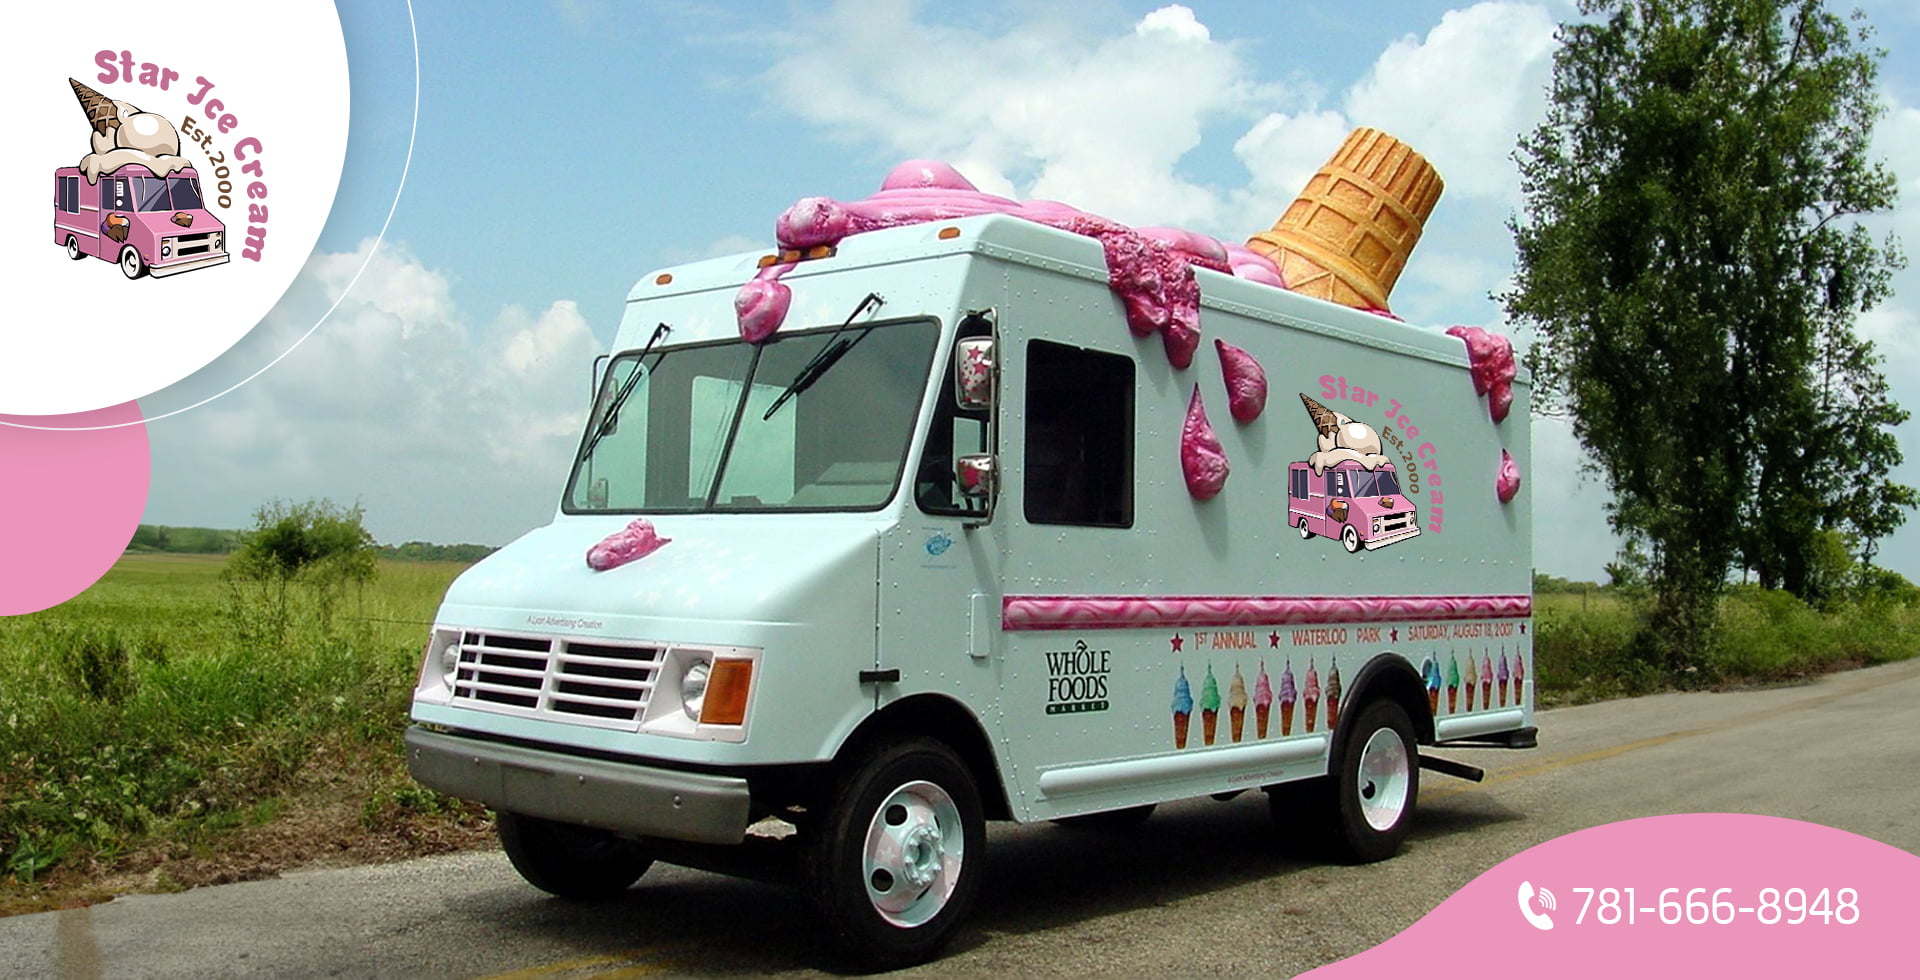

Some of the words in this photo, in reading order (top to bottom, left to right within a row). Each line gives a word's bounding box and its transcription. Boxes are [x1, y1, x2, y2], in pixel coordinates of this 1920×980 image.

[1318, 374, 1379, 407] Star
[1417, 442, 1444, 534] Cream
[1212, 631, 1257, 650] ANNUAL
[1292, 628, 1347, 646] WATERLOO
[1356, 627, 1382, 643] PARK
[1452, 623, 1484, 639] AUGUST
[1045, 640, 1112, 676] WHOLE
[1048, 675, 1108, 702] FOODS
[1048, 701, 1107, 713] MARKET
